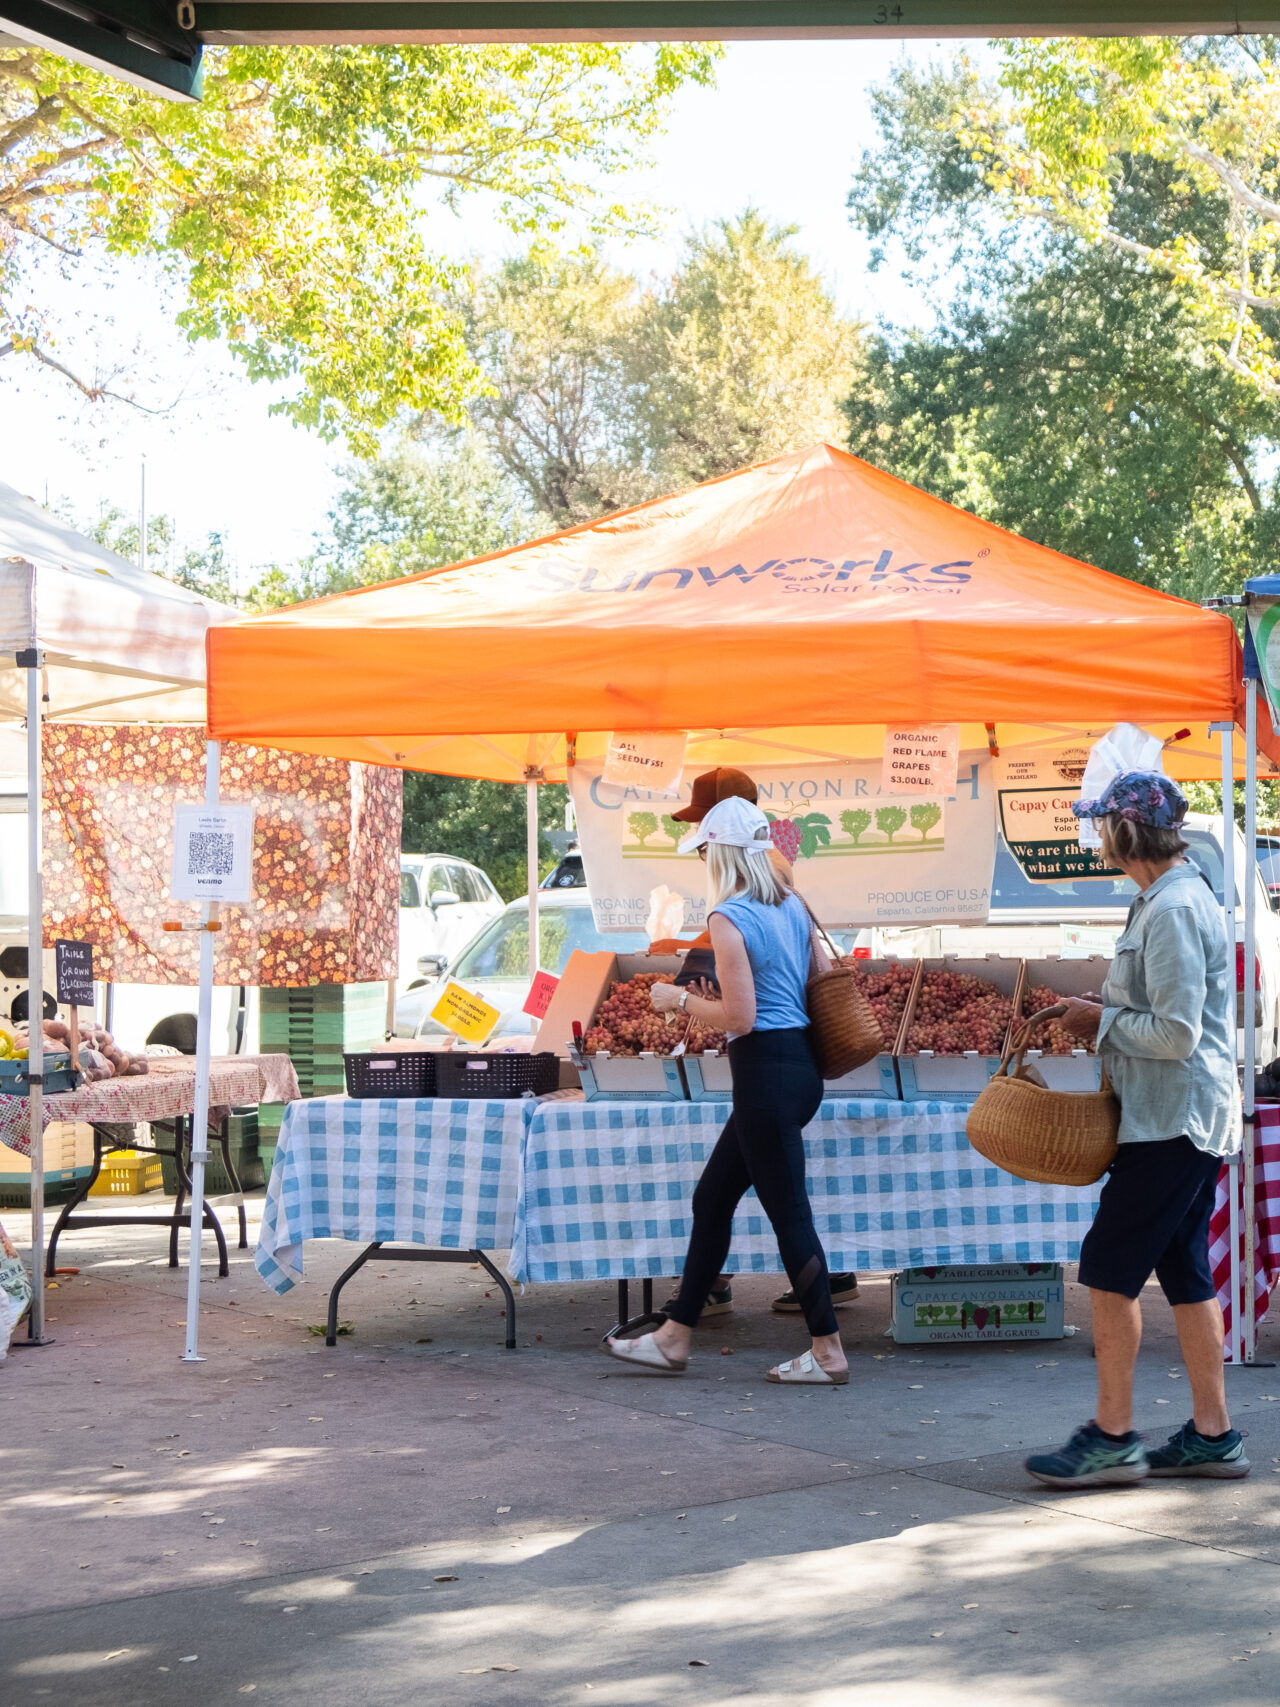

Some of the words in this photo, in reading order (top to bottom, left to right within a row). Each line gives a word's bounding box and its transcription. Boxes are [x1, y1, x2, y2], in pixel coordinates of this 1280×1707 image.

[781, 582, 861, 595] Solar
[893, 732, 938, 743] ORGANIC
[619, 742, 637, 752] ALL
[892, 747, 913, 756] RED
[914, 748, 948, 758] FLAME
[616, 752, 665, 768] SEEDLESS!
[891, 761, 931, 771] GRAPES
[890, 775, 934, 786] $3.00/LB.
[757, 778, 842, 800] NYON
[1009, 799, 1049, 813] Capay
[1013, 845, 1034, 856] We
[1038, 846, 1060, 856] are
[1028, 861, 1061, 873] what
[1065, 862, 1085, 872] we
[867, 890, 932, 904] PRODUCE
[935, 889, 954, 901] OF
[594, 897, 646, 910] RGANIC
[914, 903, 955, 914] California
[957, 903, 984, 913] 95627
[943, 1270, 976, 1278] TABLE
[977, 1269, 1020, 1277] GRAPES
[900, 1290, 952, 1308] CAPAY
[951, 1289, 1007, 1301] CANYON
[1009, 1287, 1061, 1303] RANCH
[929, 1330, 974, 1340] ORGANIC
[975, 1329, 1002, 1338] TABLE
[1005, 1328, 1041, 1338] GRAPES
